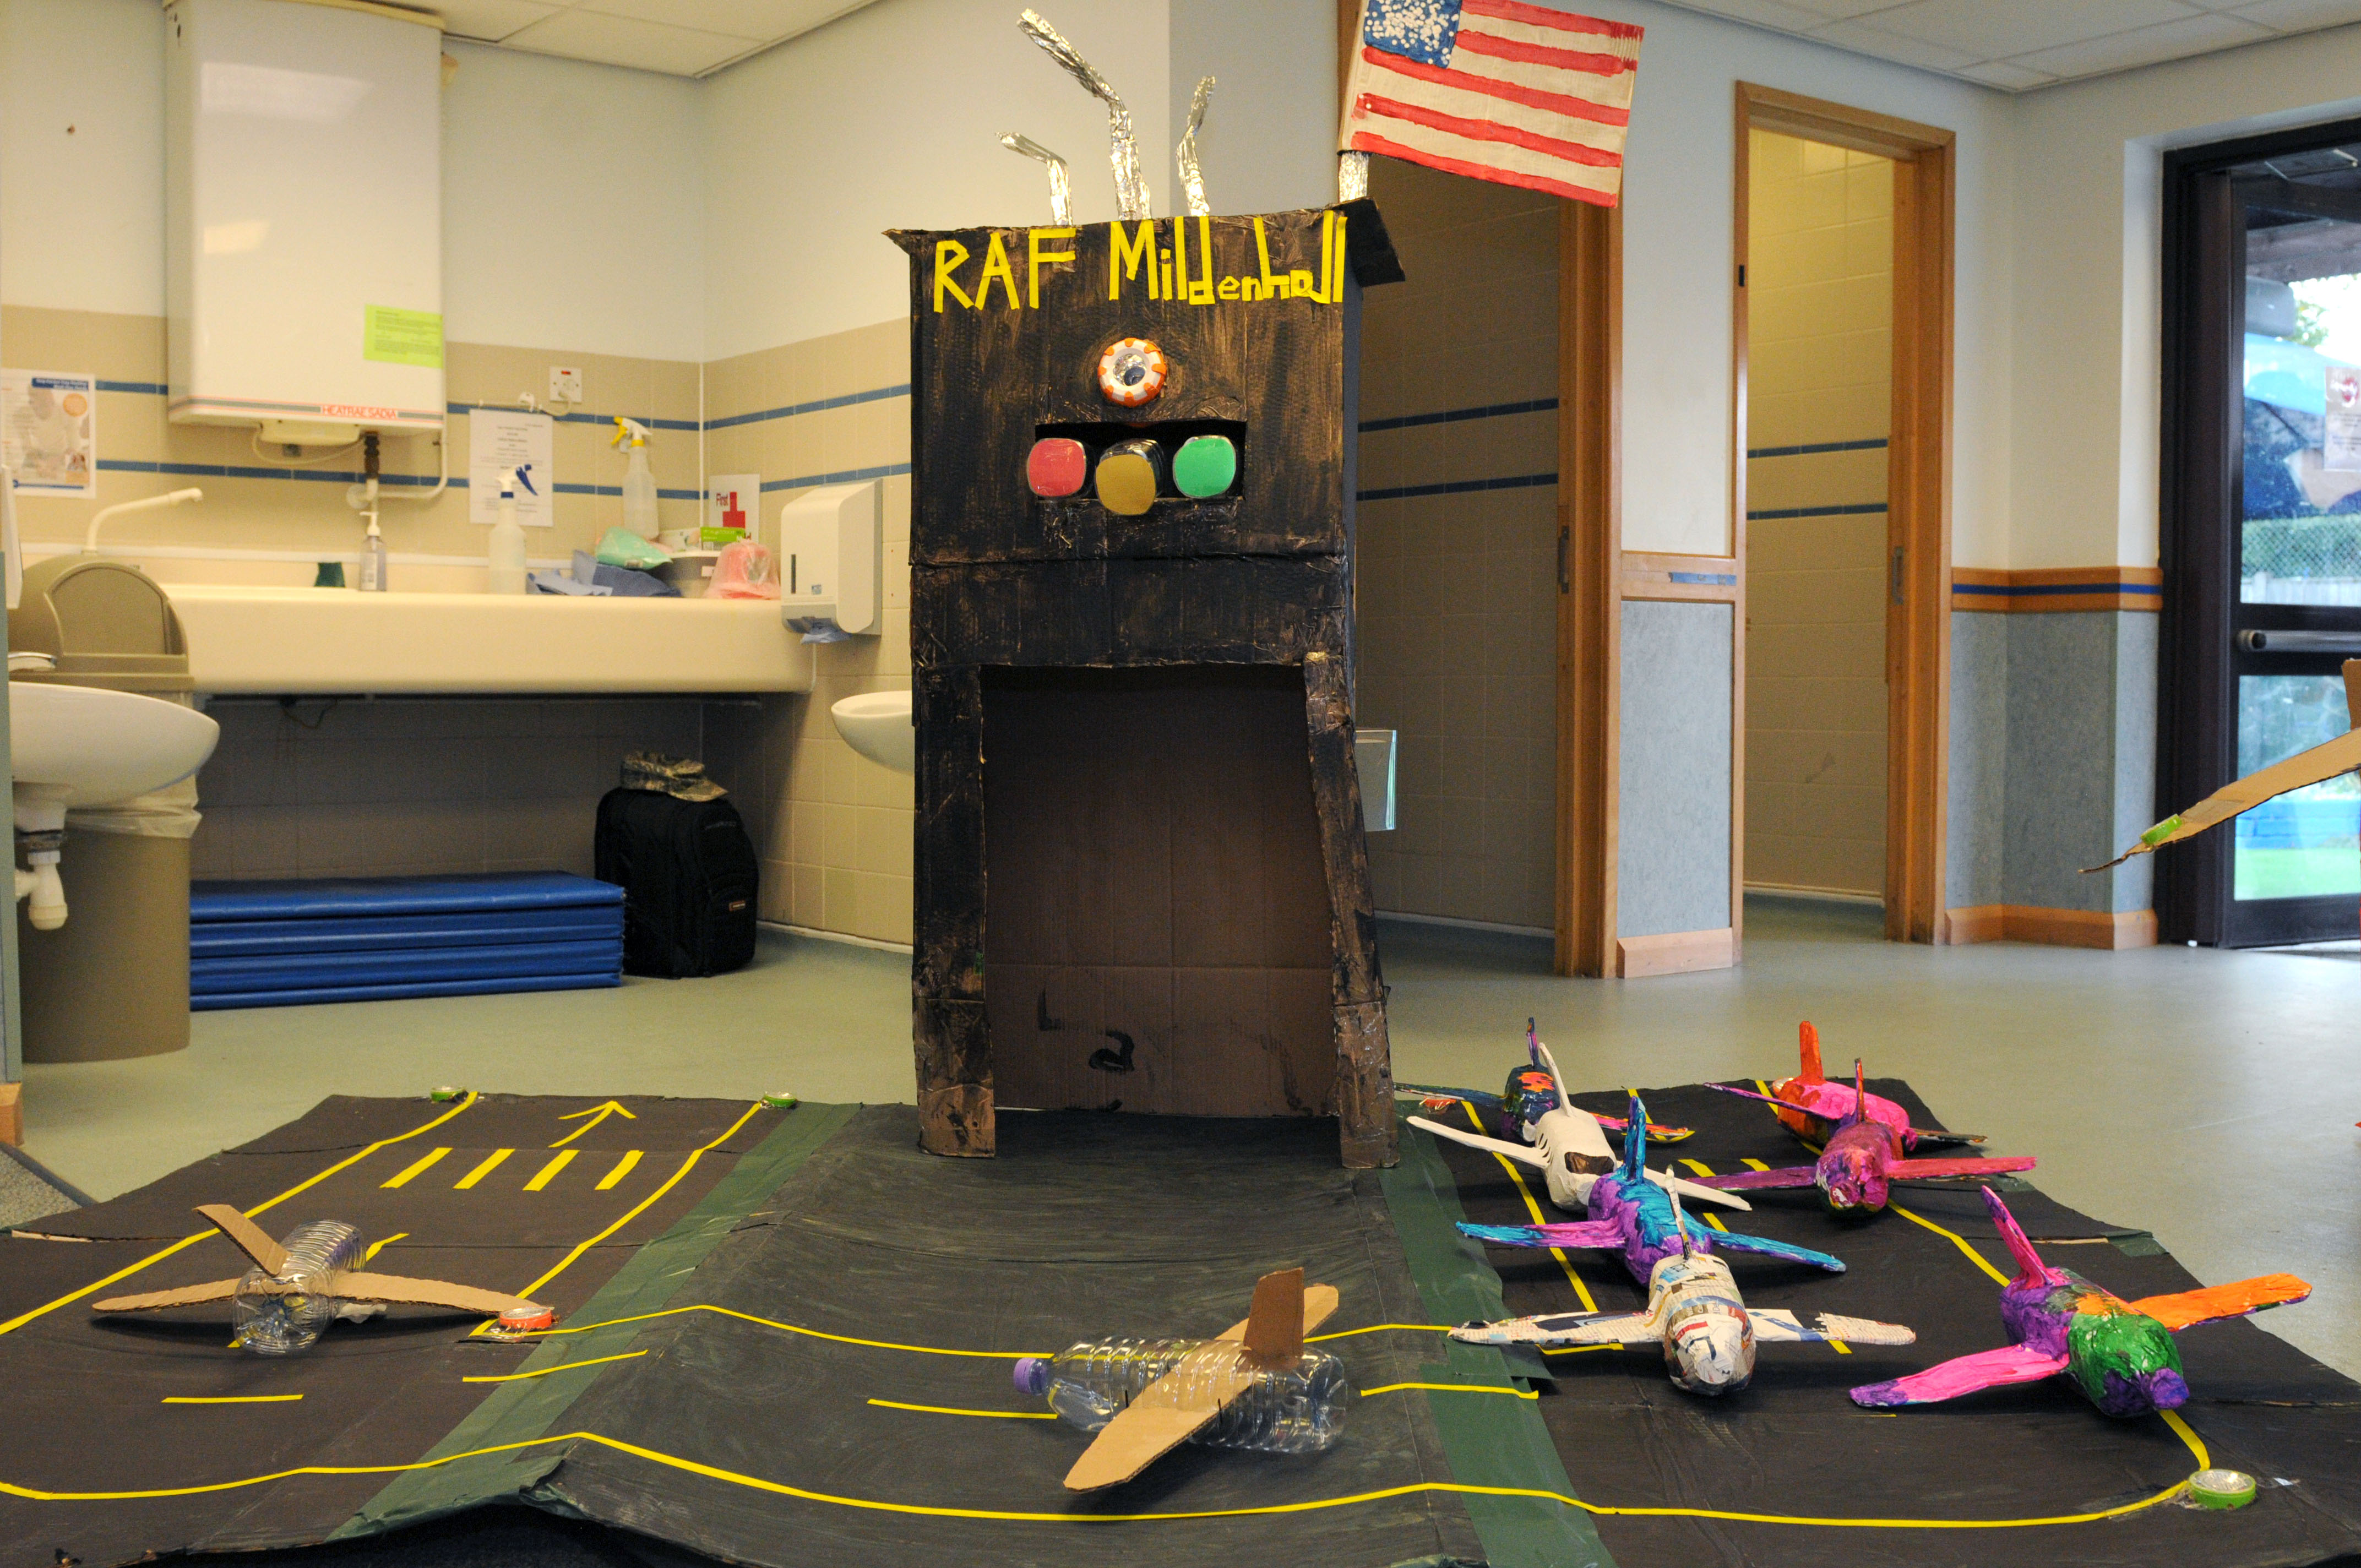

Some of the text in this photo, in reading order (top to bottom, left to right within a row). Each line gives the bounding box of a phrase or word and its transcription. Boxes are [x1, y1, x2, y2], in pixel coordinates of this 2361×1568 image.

[933, 210, 1347, 313] RAF Mildenhall
[368, 407, 397, 420] SADIA
